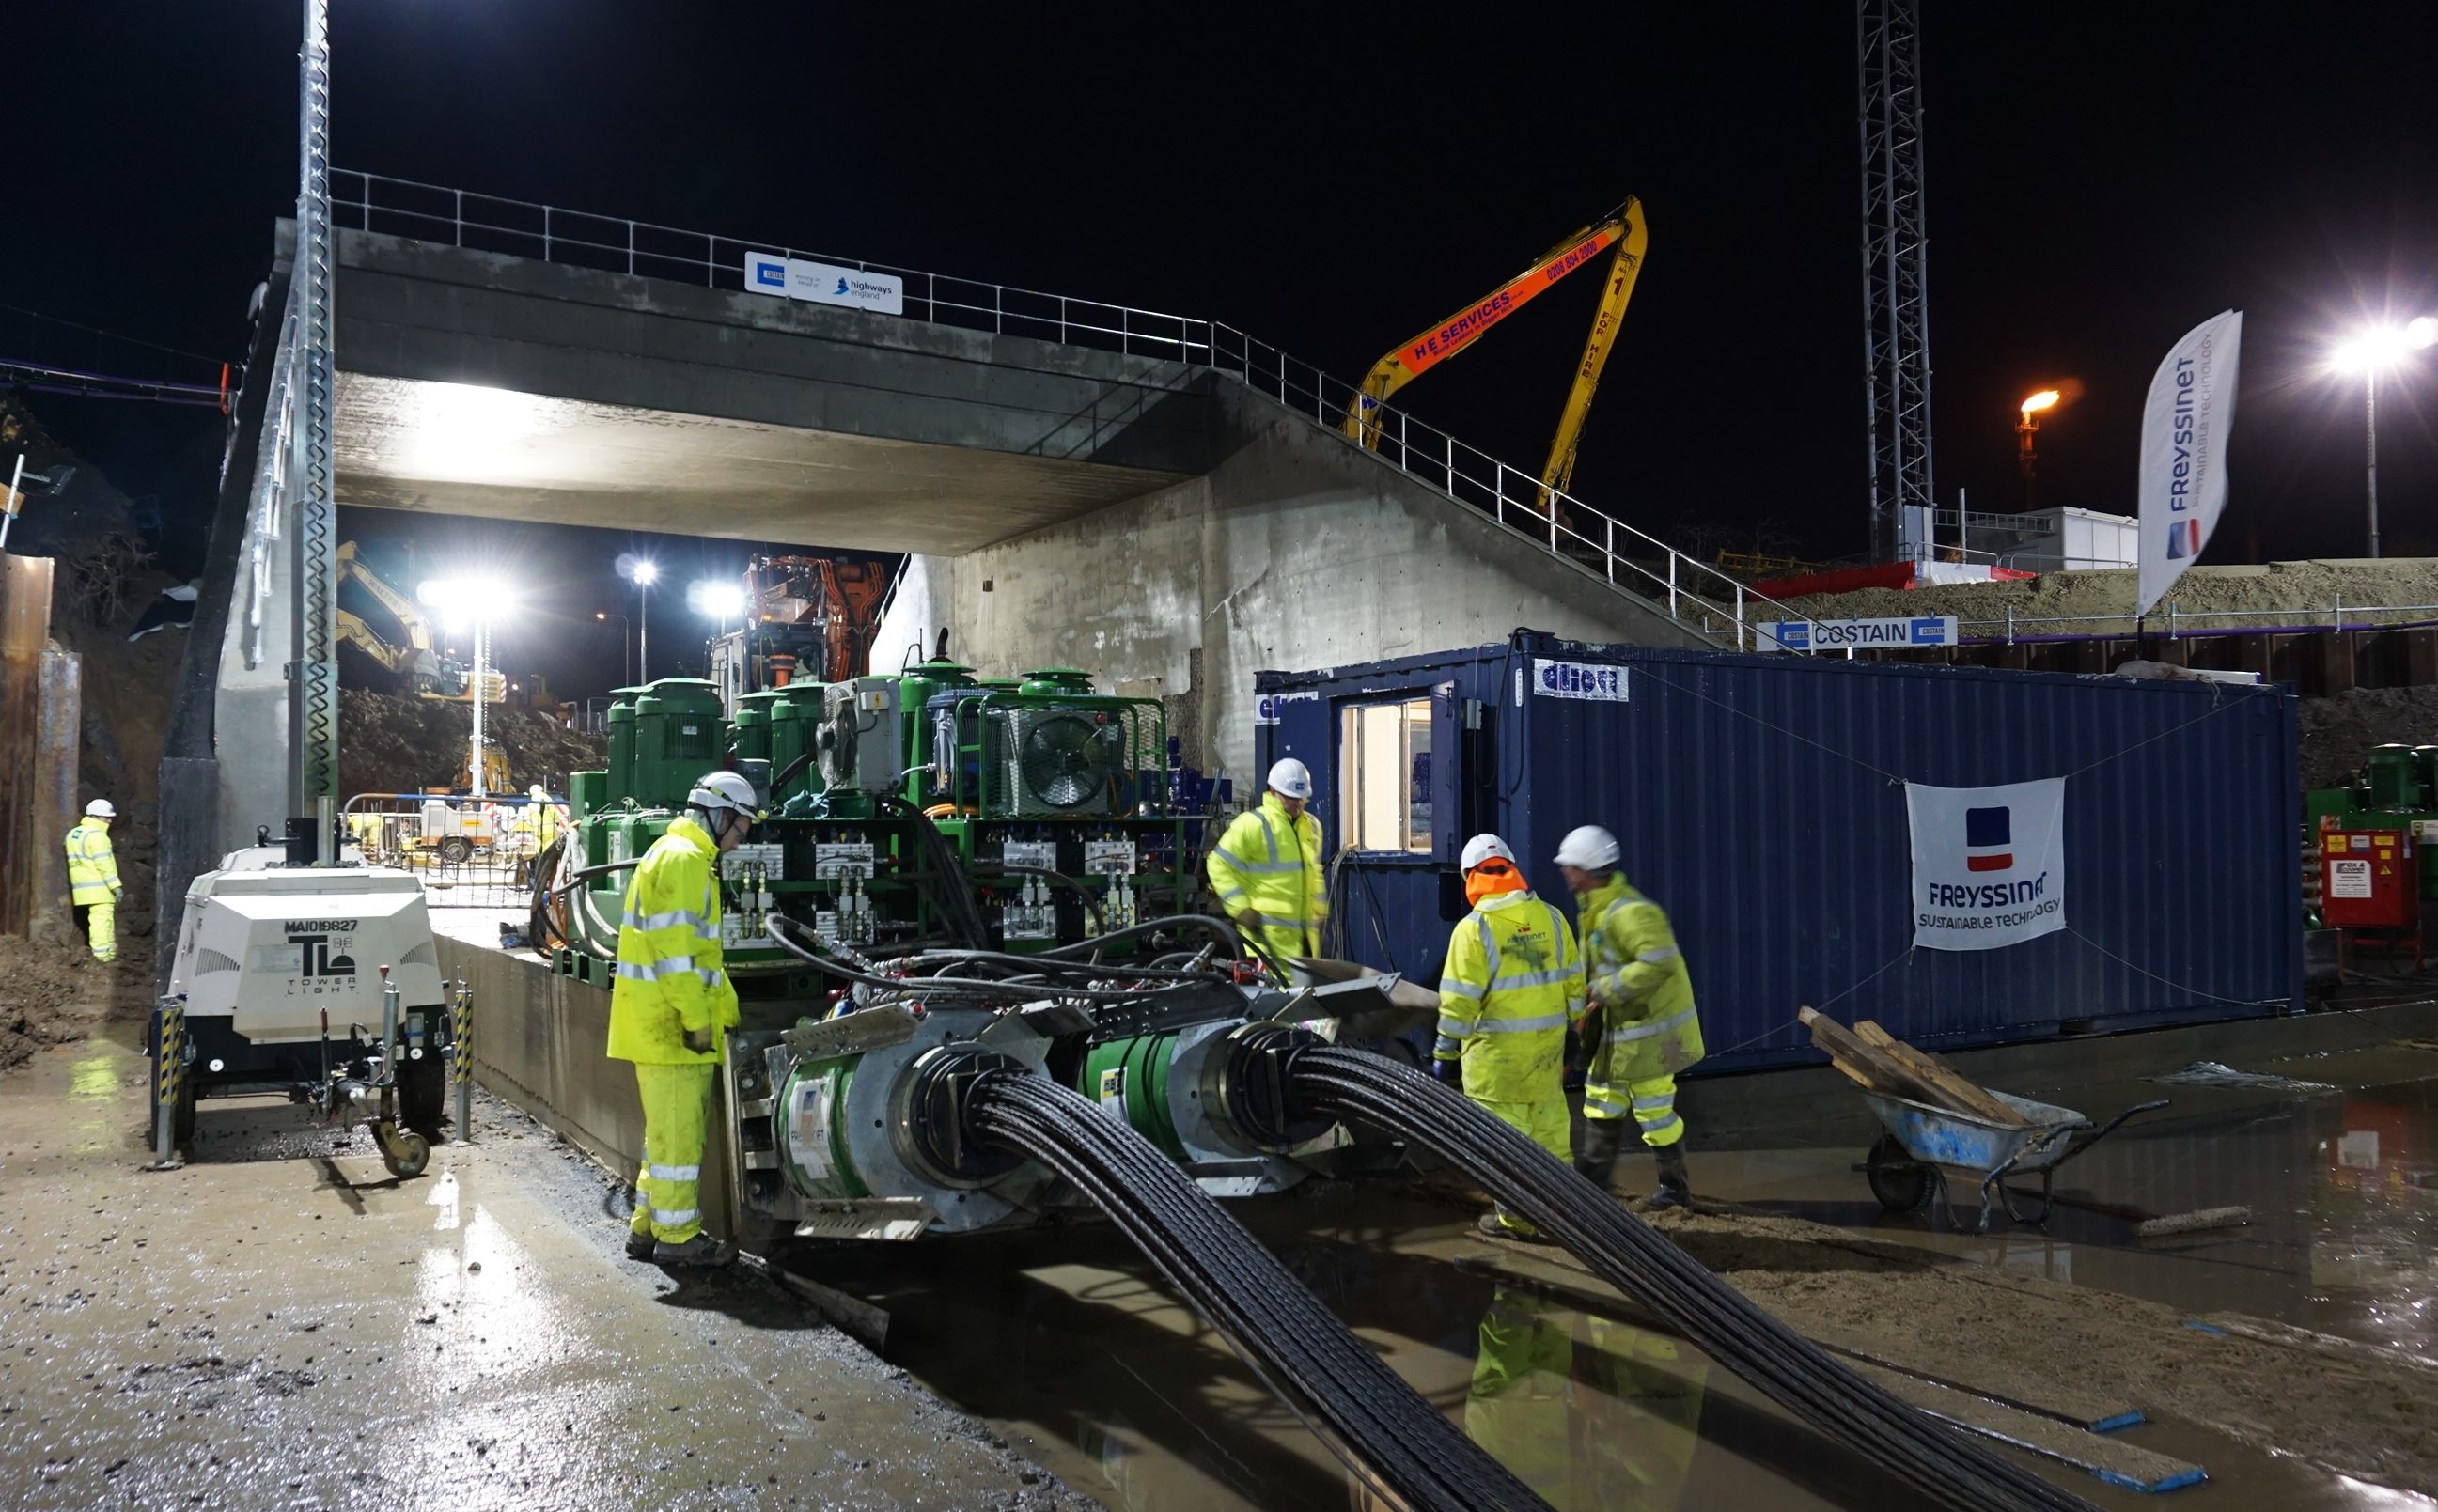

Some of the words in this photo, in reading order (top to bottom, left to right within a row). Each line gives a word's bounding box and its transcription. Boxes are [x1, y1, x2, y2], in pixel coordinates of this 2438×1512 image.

[1579, 240, 1597, 259] 2000
[851, 279, 892, 295] highways
[851, 290, 880, 300] england
[1414, 344, 1427, 360] H
[1428, 337, 1438, 352] E
[1441, 291, 1510, 344] SERVICES
[1788, 631, 1809, 640] COSTAIN
[1815, 623, 1906, 644] COSTAIN
[1922, 627, 1945, 635] COSTAIN
[288, 977, 356, 986] TOWER
[288, 986, 355, 995] LIGHT
